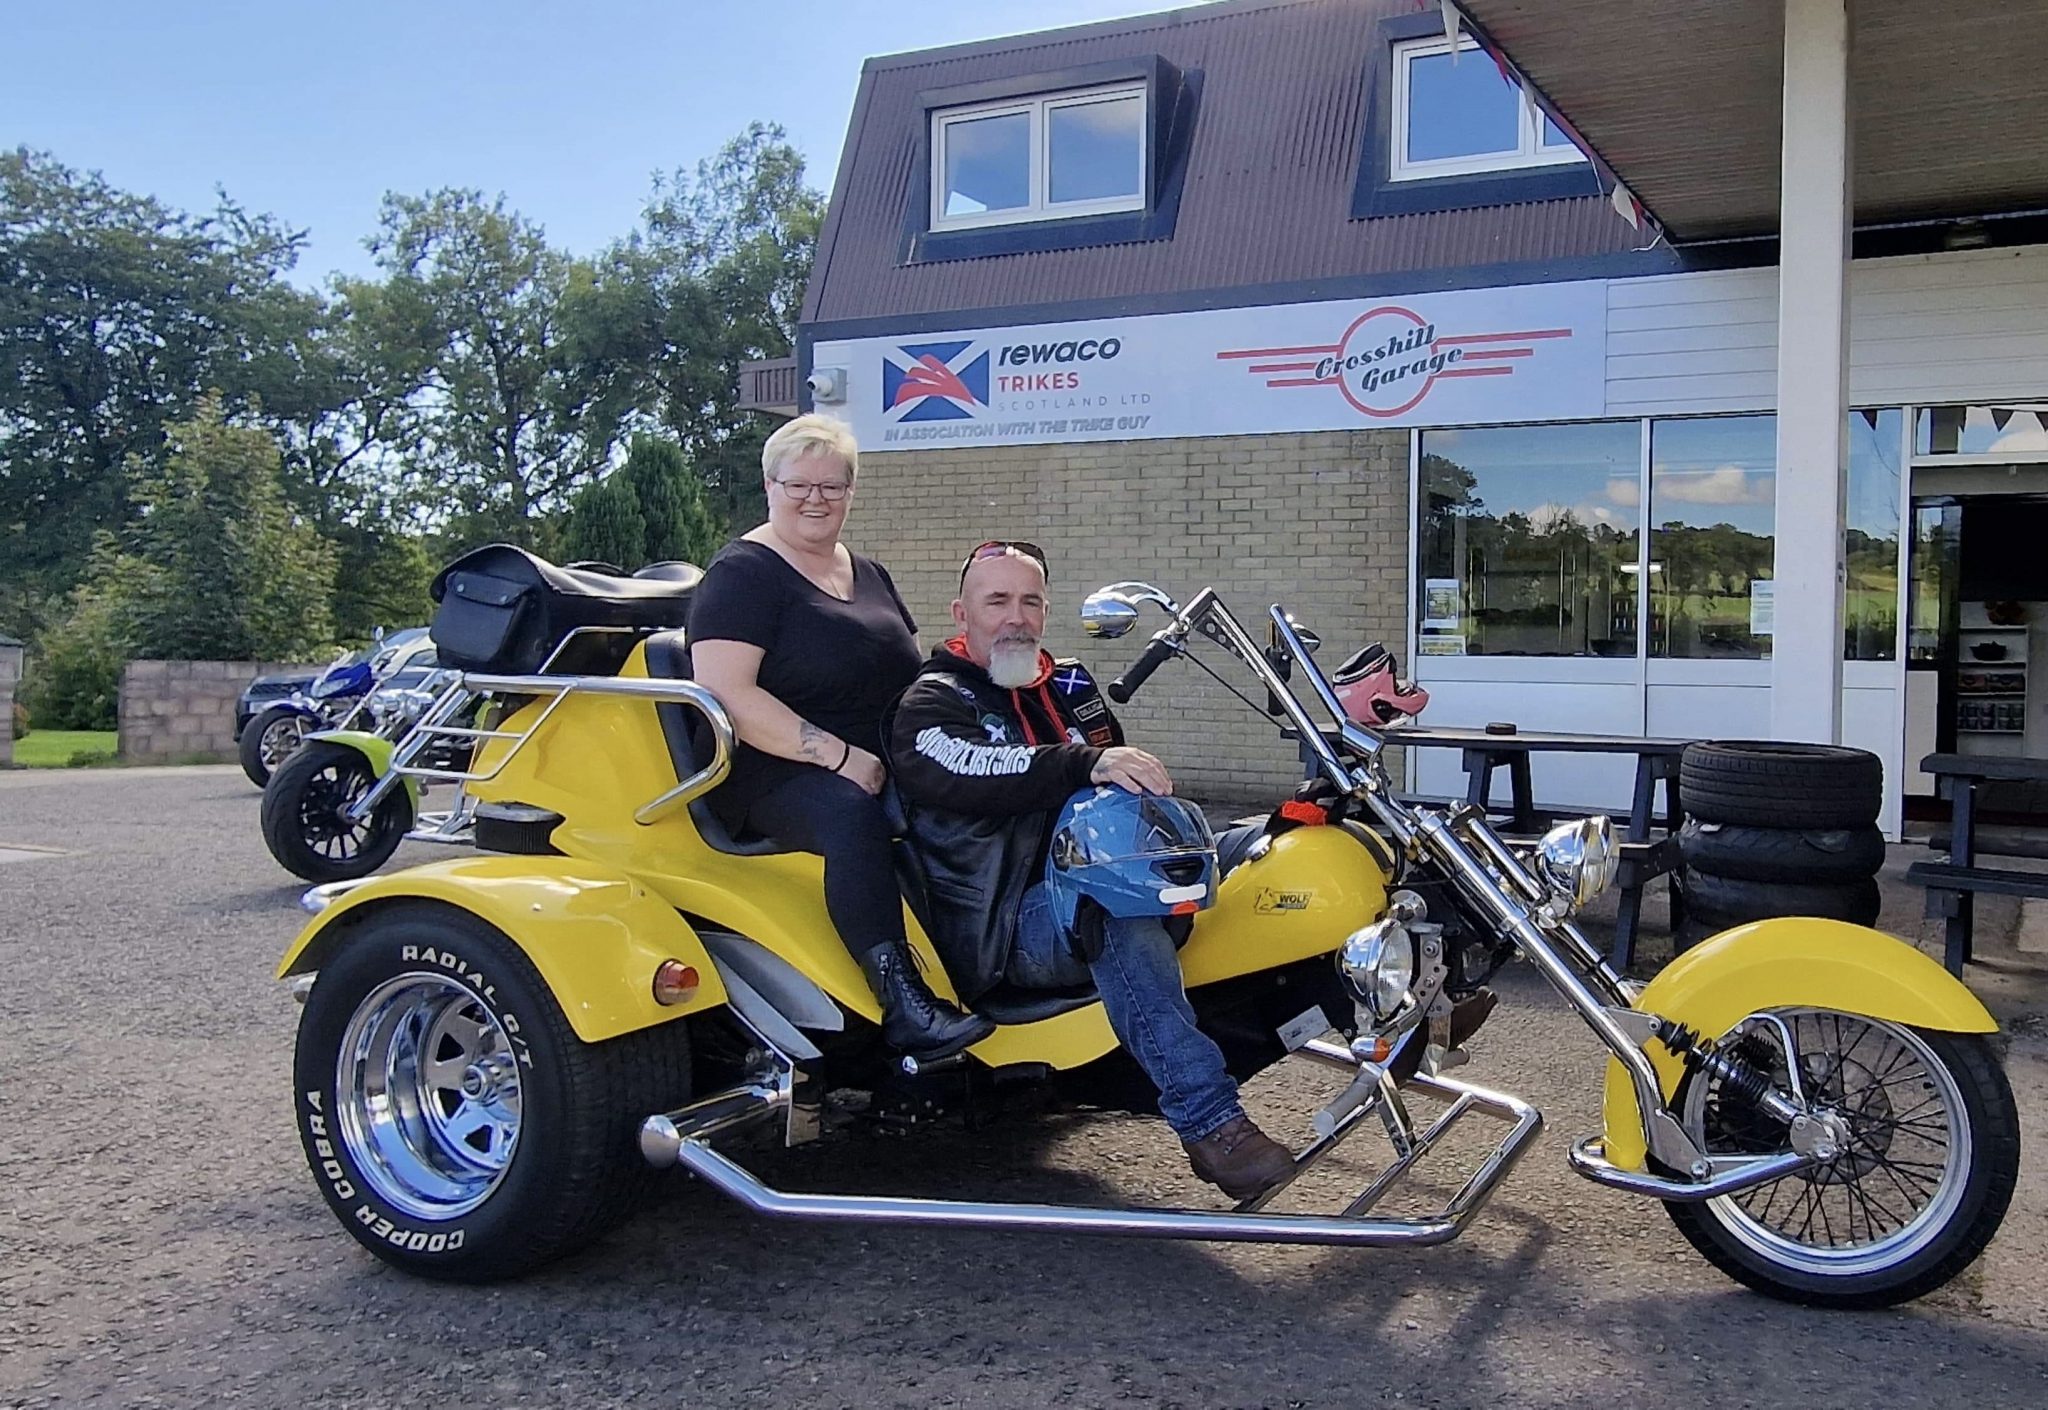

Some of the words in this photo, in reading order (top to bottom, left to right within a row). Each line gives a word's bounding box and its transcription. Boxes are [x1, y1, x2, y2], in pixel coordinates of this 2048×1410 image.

[998, 338, 1121, 366] rewaco
[1315, 324, 1435, 379] Crosshill
[1361, 348, 1463, 393] Garage
[998, 372, 1079, 393] TRIKES
[998, 396, 1108, 412] SCOTLAND
[1121, 393, 1152, 406] LTD
[884, 428, 900, 441] IN
[900, 423, 995, 441] ASSOCIATION
[997, 421, 1036, 436] WITH
[1038, 420, 1068, 434] THE
[1071, 417, 1115, 432] TRIKE
[1117, 415, 1152, 431] GUY
[402, 945, 497, 1006] RADIAL
[503, 1013, 533, 1070] G/T
[306, 1090, 356, 1200] COBRA
[355, 1204, 466, 1252] COOPER
